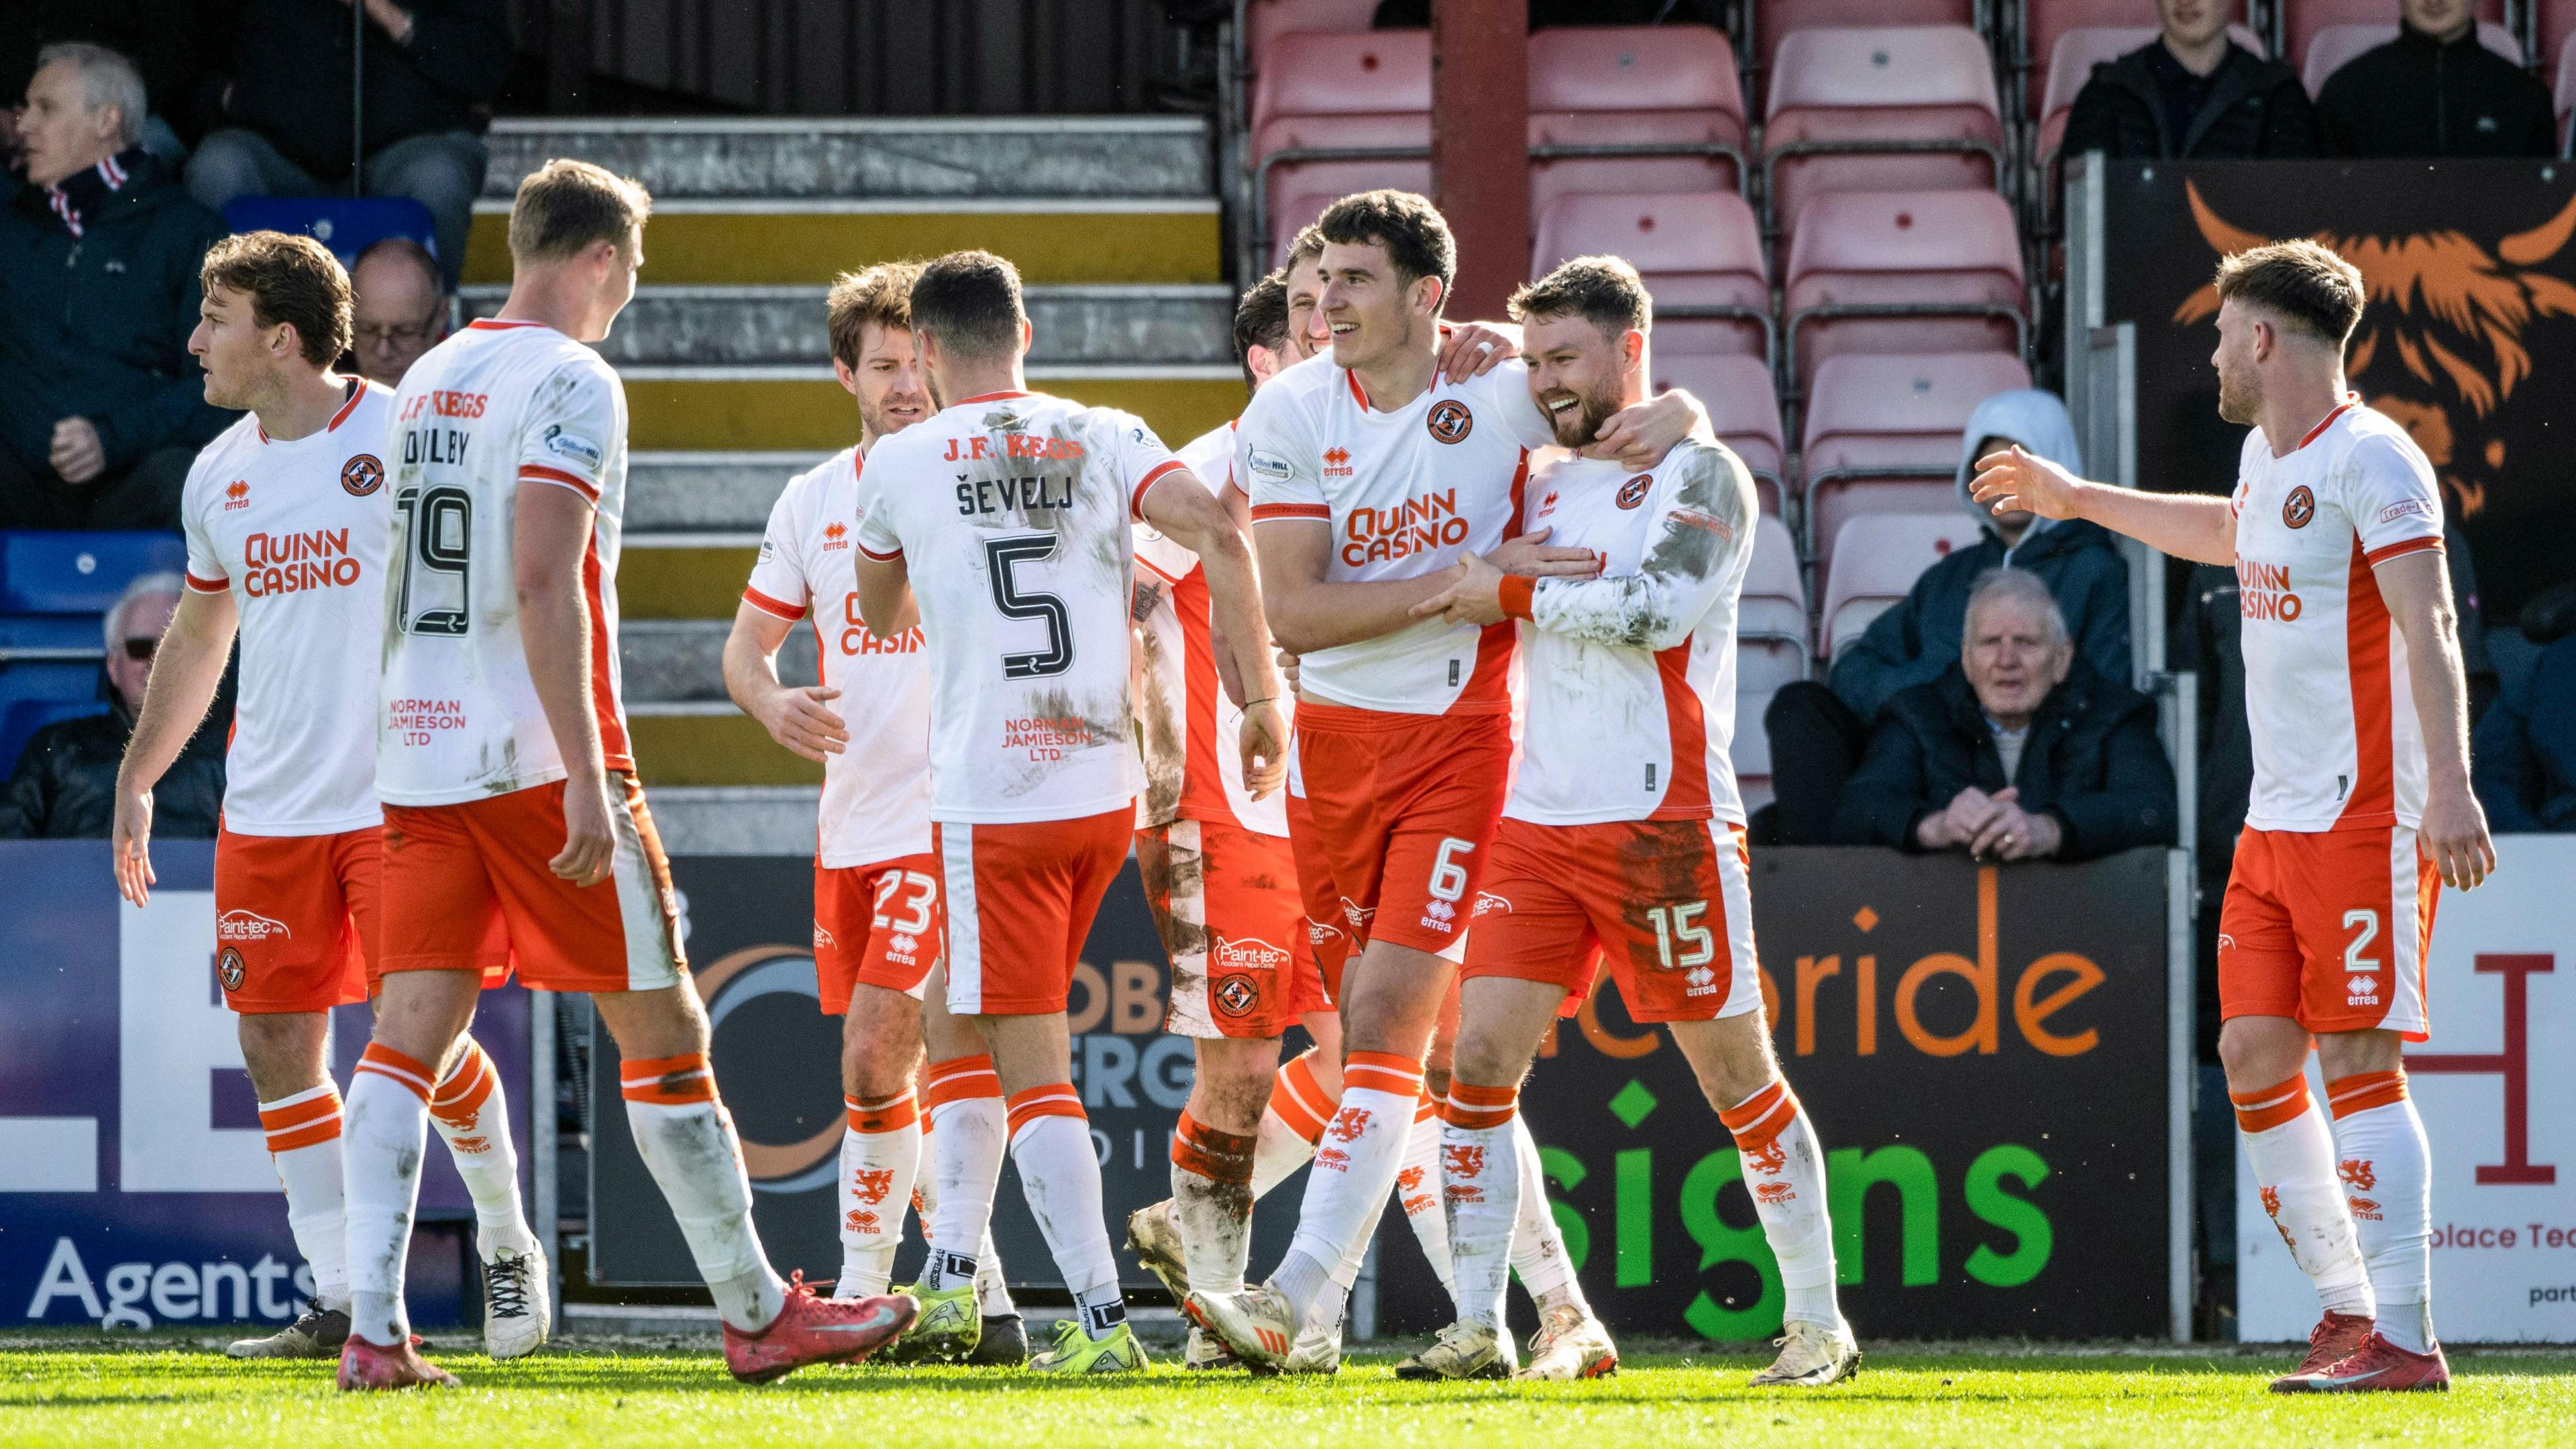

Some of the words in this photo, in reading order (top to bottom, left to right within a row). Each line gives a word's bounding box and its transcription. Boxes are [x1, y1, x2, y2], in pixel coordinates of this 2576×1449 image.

[431, 390, 488, 419] KEGS
[943, 439, 996, 462] J.F.
[1004, 434, 1085, 460] KEGS
[1272, 461, 1289, 471] HILL
[1324, 466, 1352, 477] errea
[955, 474, 1073, 516] ŠEVELJ
[225, 498, 250, 511] errea
[1348, 488, 1456, 543] QUINN
[245, 528, 349, 570] QUINN
[822, 541, 848, 551] errea
[1342, 517, 1468, 568] CASINO
[394, 483, 472, 638] 19
[244, 557, 361, 598] CASINO
[983, 532, 1076, 681] 5
[2241, 589, 2302, 623] ASINO
[841, 625, 926, 656] CASIN
[389, 700, 460, 714] NORMAN
[388, 716, 466, 730] JAMIESON
[1006, 716, 1084, 733] NORMAN
[403, 732, 431, 747] LTD
[1002, 731, 1093, 749] JAMIESON
[1029, 748, 1062, 762] LTD
[1428, 836, 1476, 903] 6
[873, 868, 937, 936] 23
[1421, 916, 1452, 933] errea
[1647, 900, 1715, 969] 15
[2343, 908, 2381, 973] 2
[886, 951, 916, 966] errea
[1221, 946, 1279, 963] Paint-tec
[1686, 983, 1717, 997] errea
[2348, 996, 2379, 1006] errea
[1315, 1159, 1348, 1173] errea
[845, 1222, 881, 1234] errea
